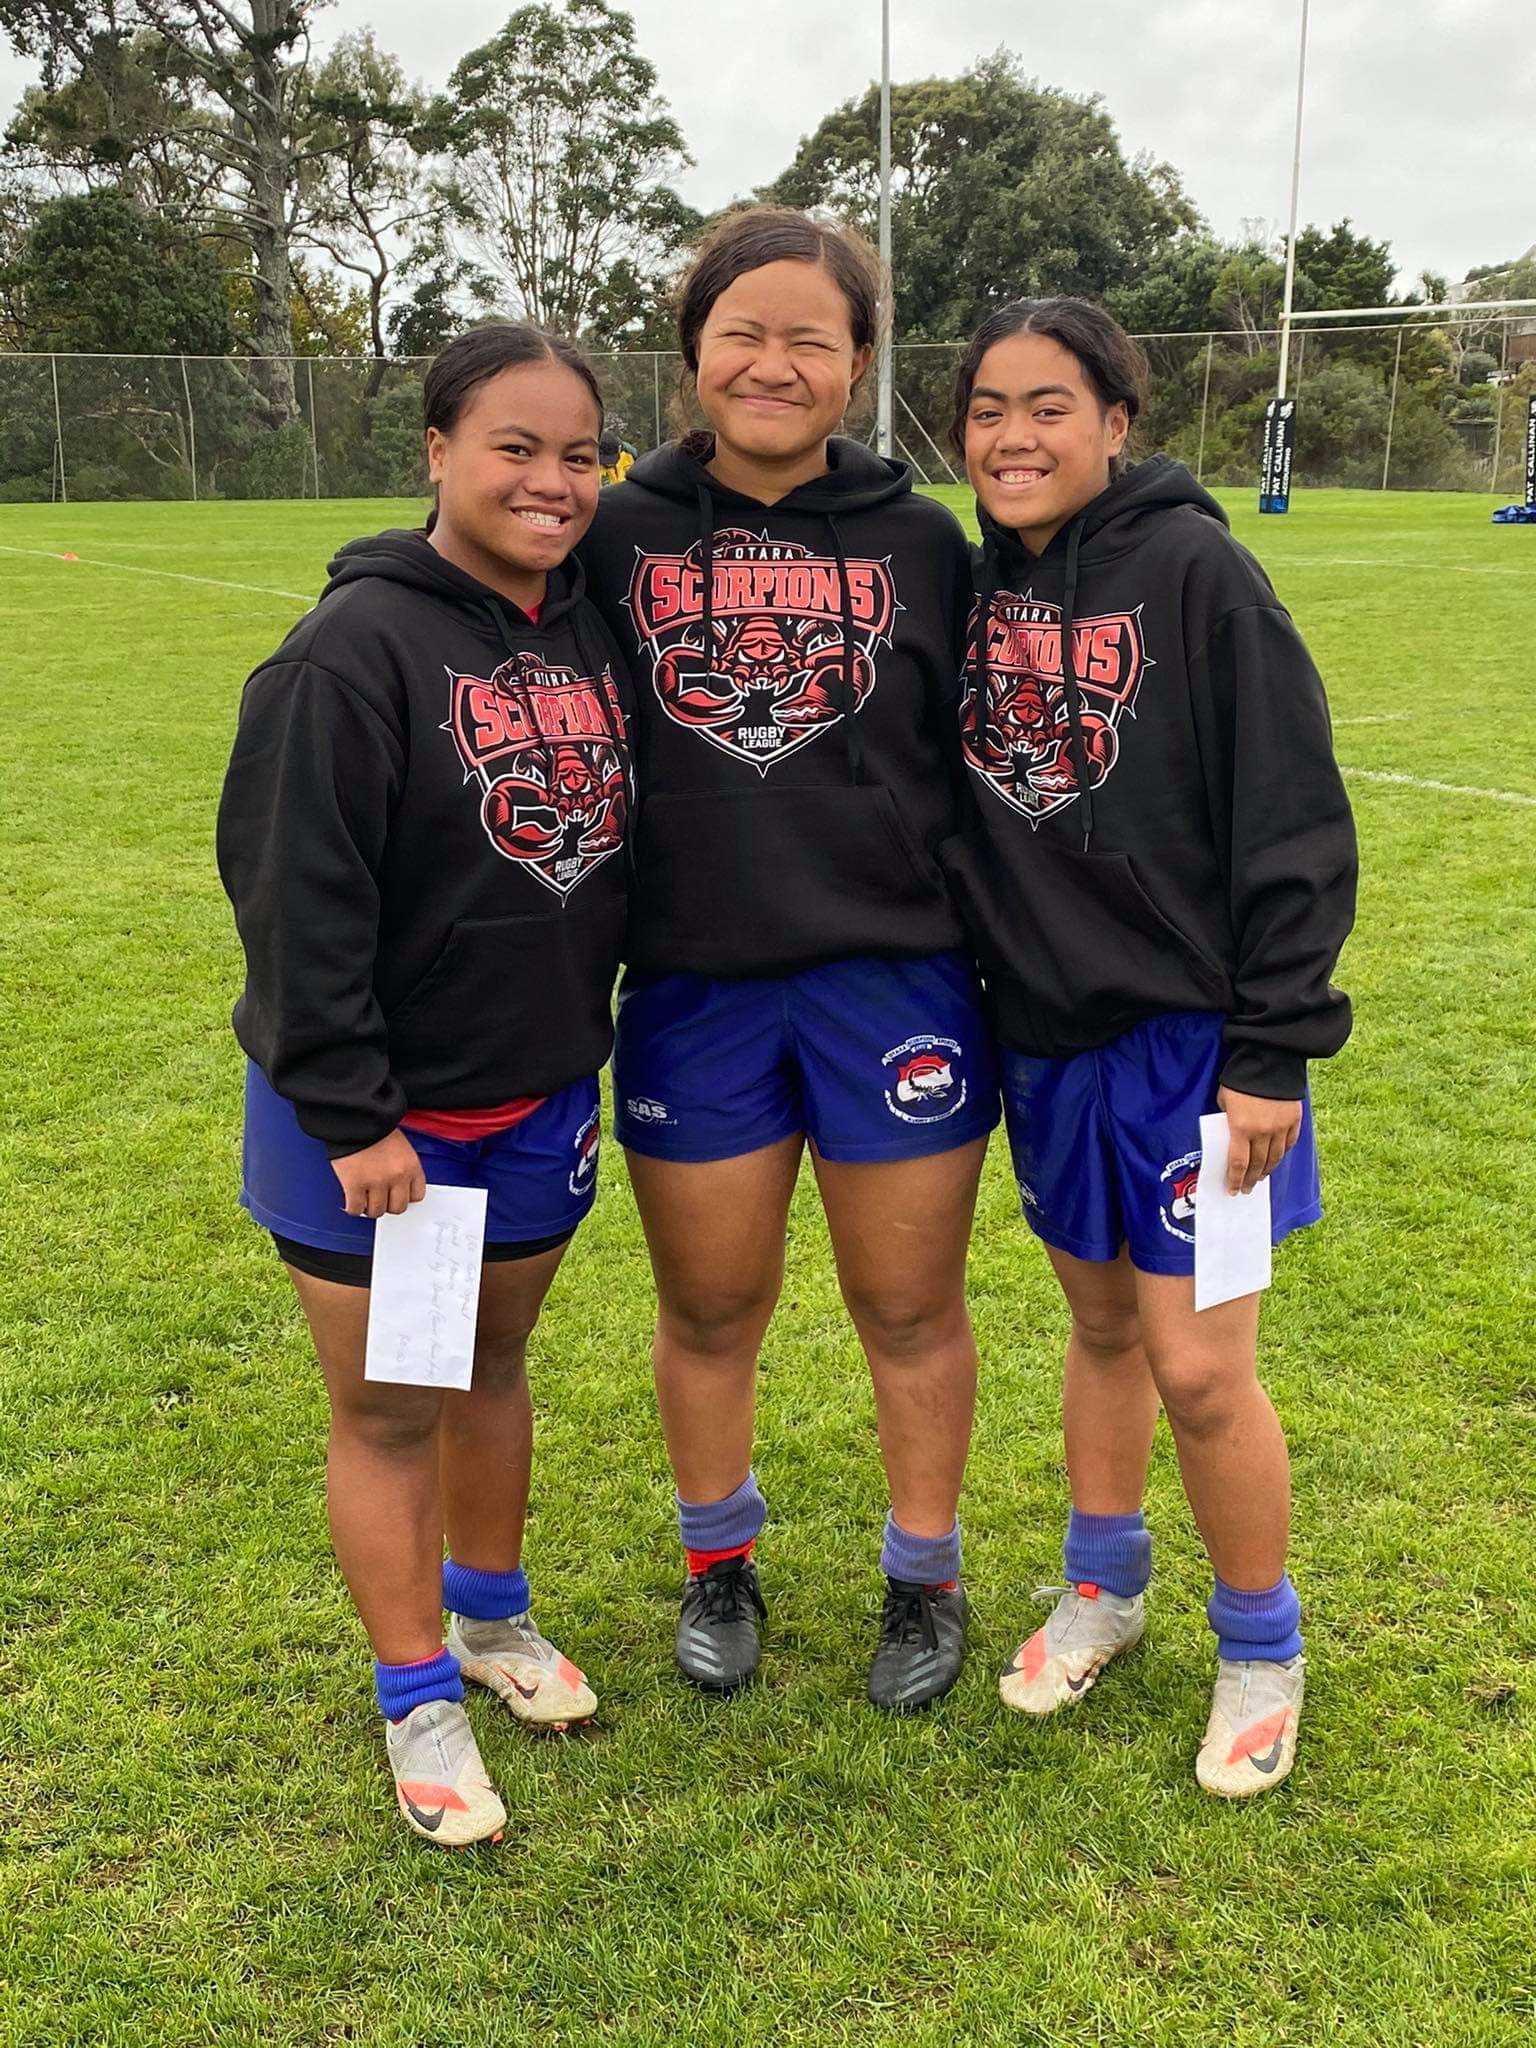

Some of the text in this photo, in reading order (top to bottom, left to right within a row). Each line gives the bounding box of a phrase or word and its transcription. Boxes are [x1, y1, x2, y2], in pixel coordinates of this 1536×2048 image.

[1272, 420, 1286, 495] PAT CALLINAN
[1526, 418, 1536, 503] PAT CALLINAN
[1281, 447, 1292, 496] ACCOUNTING
[735, 546, 794, 561] OTARA
[650, 564, 875, 622] SCORPIONS
[1004, 606, 1051, 623] OTARA
[534, 671, 570, 687] OTARA
[737, 726, 786, 740] RUGBY
[742, 738, 782, 749] LEAGUE
